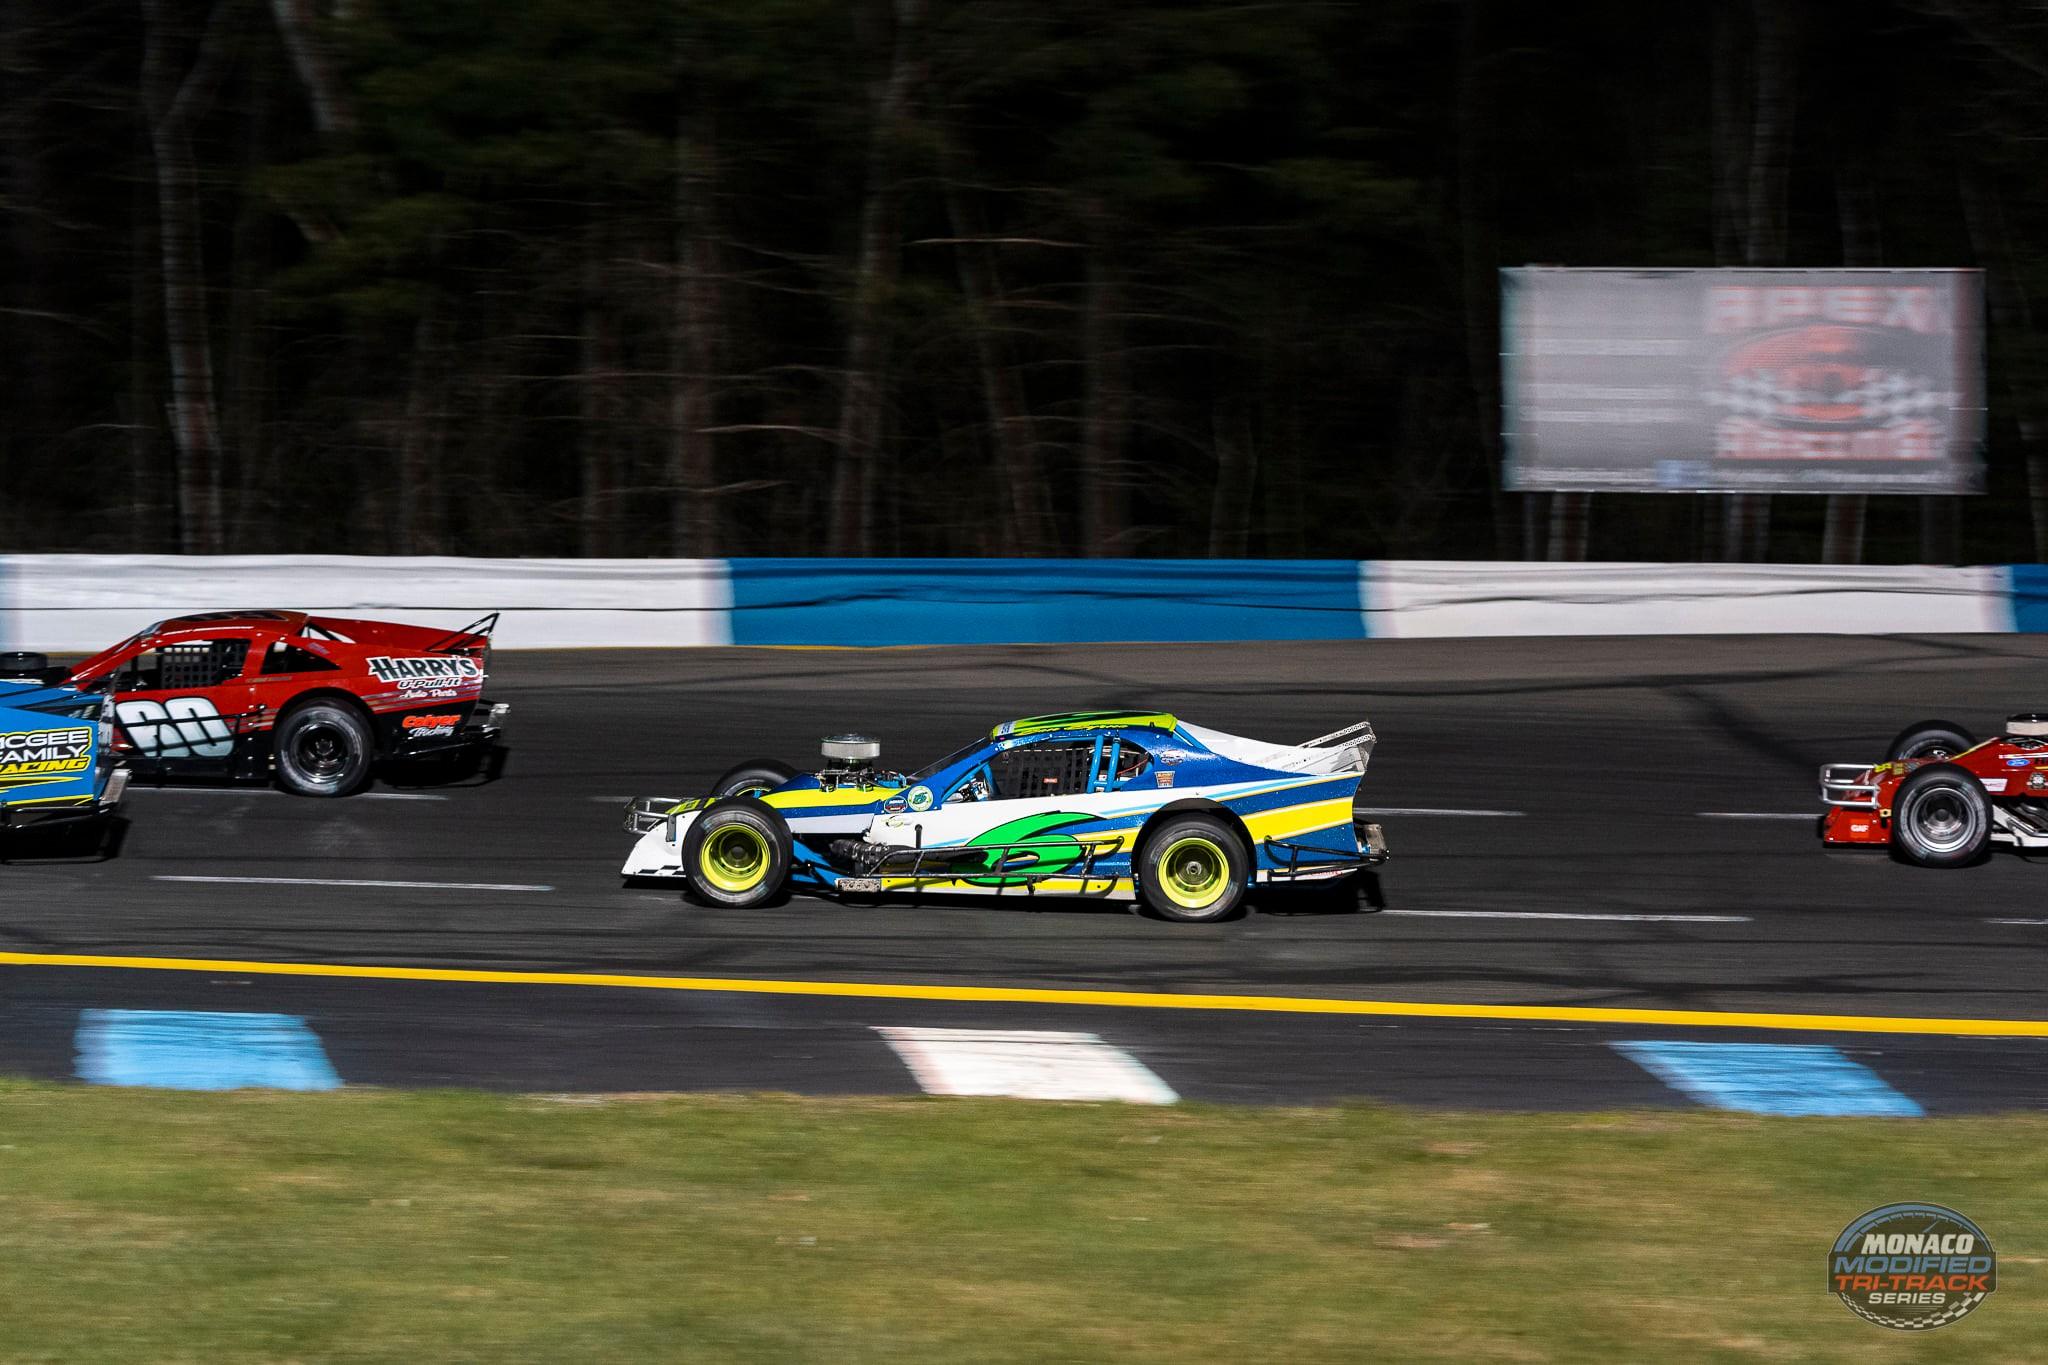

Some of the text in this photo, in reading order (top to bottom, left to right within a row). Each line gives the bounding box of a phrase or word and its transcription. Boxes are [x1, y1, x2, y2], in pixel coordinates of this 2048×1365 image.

[366, 656, 479, 682] HARRY'S
[0, 730, 89, 749] CGEE
[0, 745, 88, 764] AMILY
[0, 758, 88, 775] ACING
